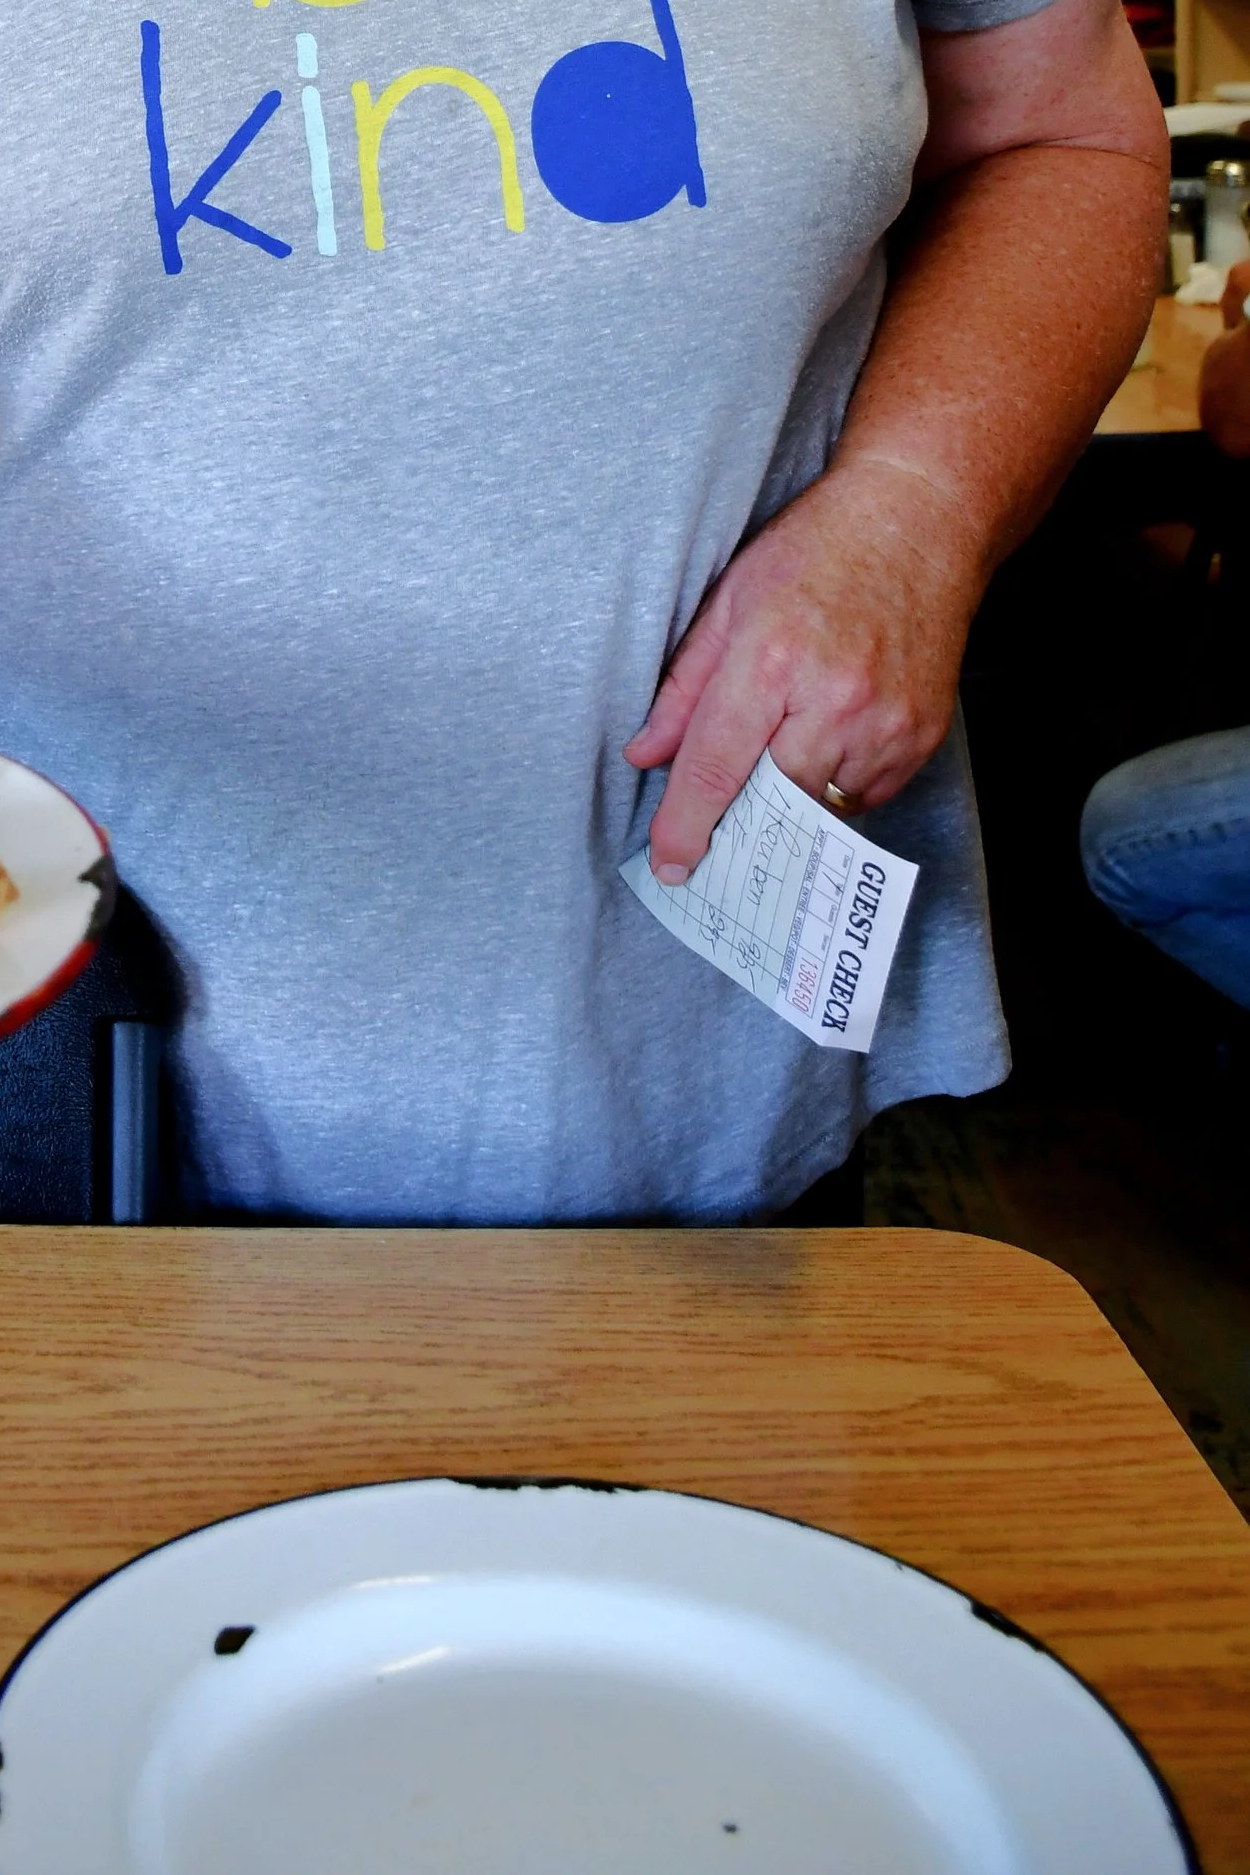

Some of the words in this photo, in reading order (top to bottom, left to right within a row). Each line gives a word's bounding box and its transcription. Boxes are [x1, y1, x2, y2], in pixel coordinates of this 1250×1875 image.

[746, 811, 802, 906] Reuben
[845, 861, 886, 950] GUEST
[791, 957, 819, 1013] 136450
[821, 950, 862, 1032] CHECK
